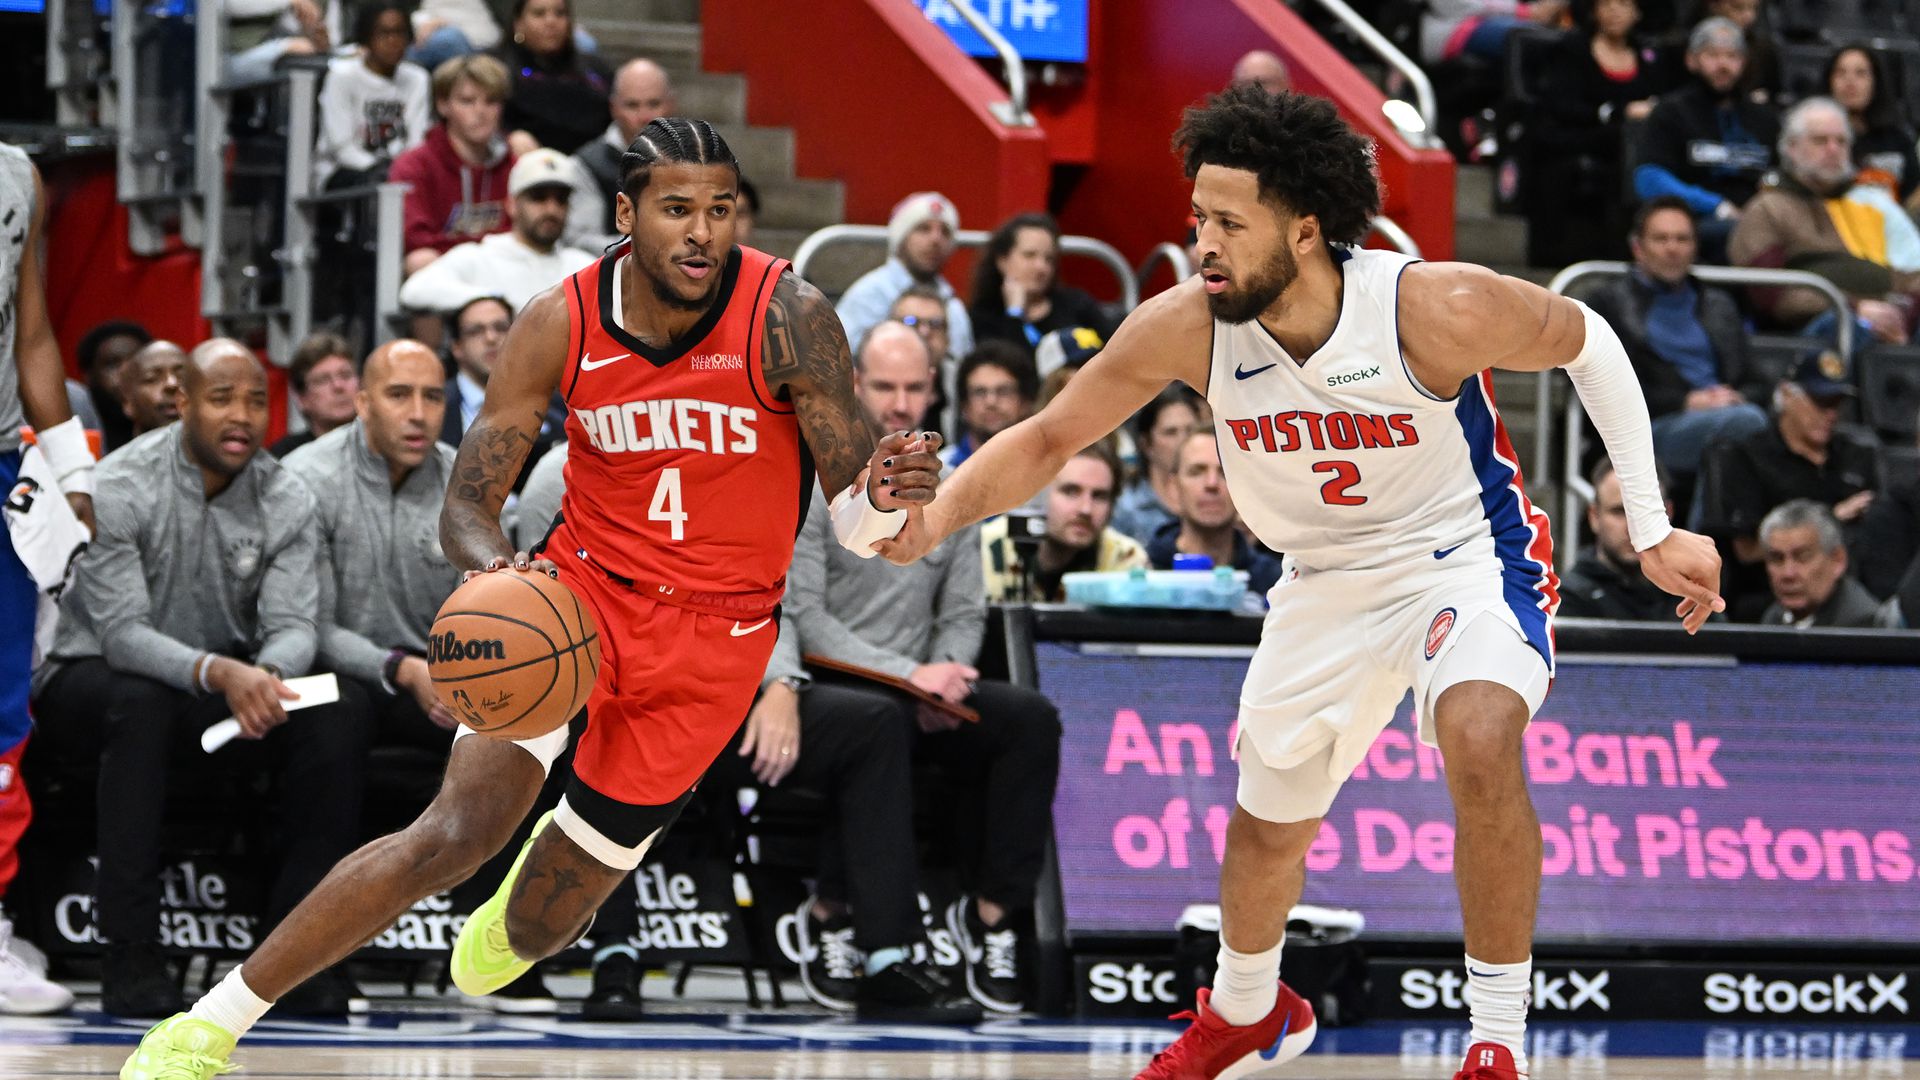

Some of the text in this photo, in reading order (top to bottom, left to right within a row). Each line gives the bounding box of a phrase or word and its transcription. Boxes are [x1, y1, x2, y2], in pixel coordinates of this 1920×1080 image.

[691, 353, 743, 363] MEMORIAL
[691, 361, 743, 370] HERMANN
[1327, 365, 1381, 387] StockX
[574, 398, 757, 455] ROCKETS
[1225, 410, 1420, 453] PISTONS
[647, 467, 689, 541] 4
[1311, 460, 1368, 506] 2
[1104, 709, 1215, 776] An
[1523, 720, 1729, 788] Bank
[1111, 798, 1920, 882] of te Deoit Pistons
[1088, 962, 1179, 1004] Sto
[1400, 968, 1611, 1011] StkX
[1704, 972, 1909, 1014] StockX
